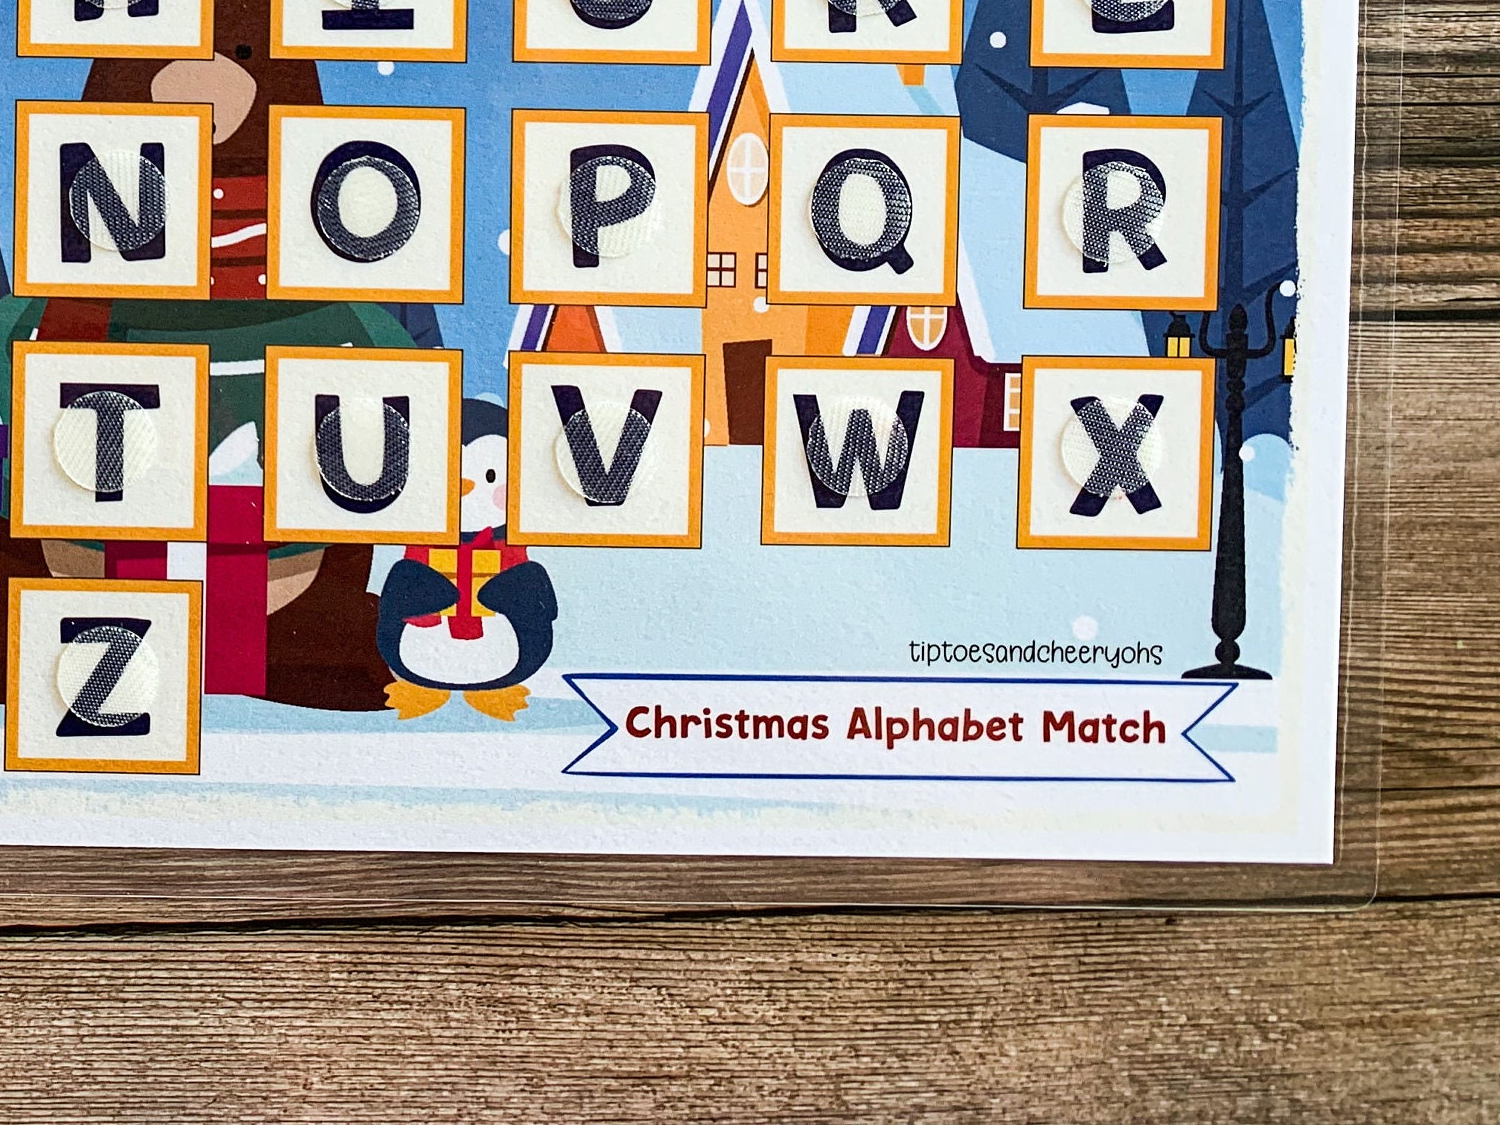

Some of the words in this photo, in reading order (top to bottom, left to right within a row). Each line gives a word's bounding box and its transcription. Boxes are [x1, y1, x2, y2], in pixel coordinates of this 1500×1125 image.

[60, 142, 166, 263] N
[310, 141, 421, 263] O
[569, 144, 656, 268] P
[811, 149, 914, 275] Q
[1082, 149, 1167, 273] R
[60, 383, 160, 502] T
[315, 394, 410, 514] U
[551, 385, 662, 506] V
[793, 390, 925, 510] W
[1069, 394, 1164, 517] X
[56, 617, 152, 737] Z
[908, 639, 1164, 668] tiptoesandcheeryohs
[625, 706, 830, 740] Christmas
[846, 705, 1024, 750] Alphabet
[1042, 710, 1167, 744] Match
